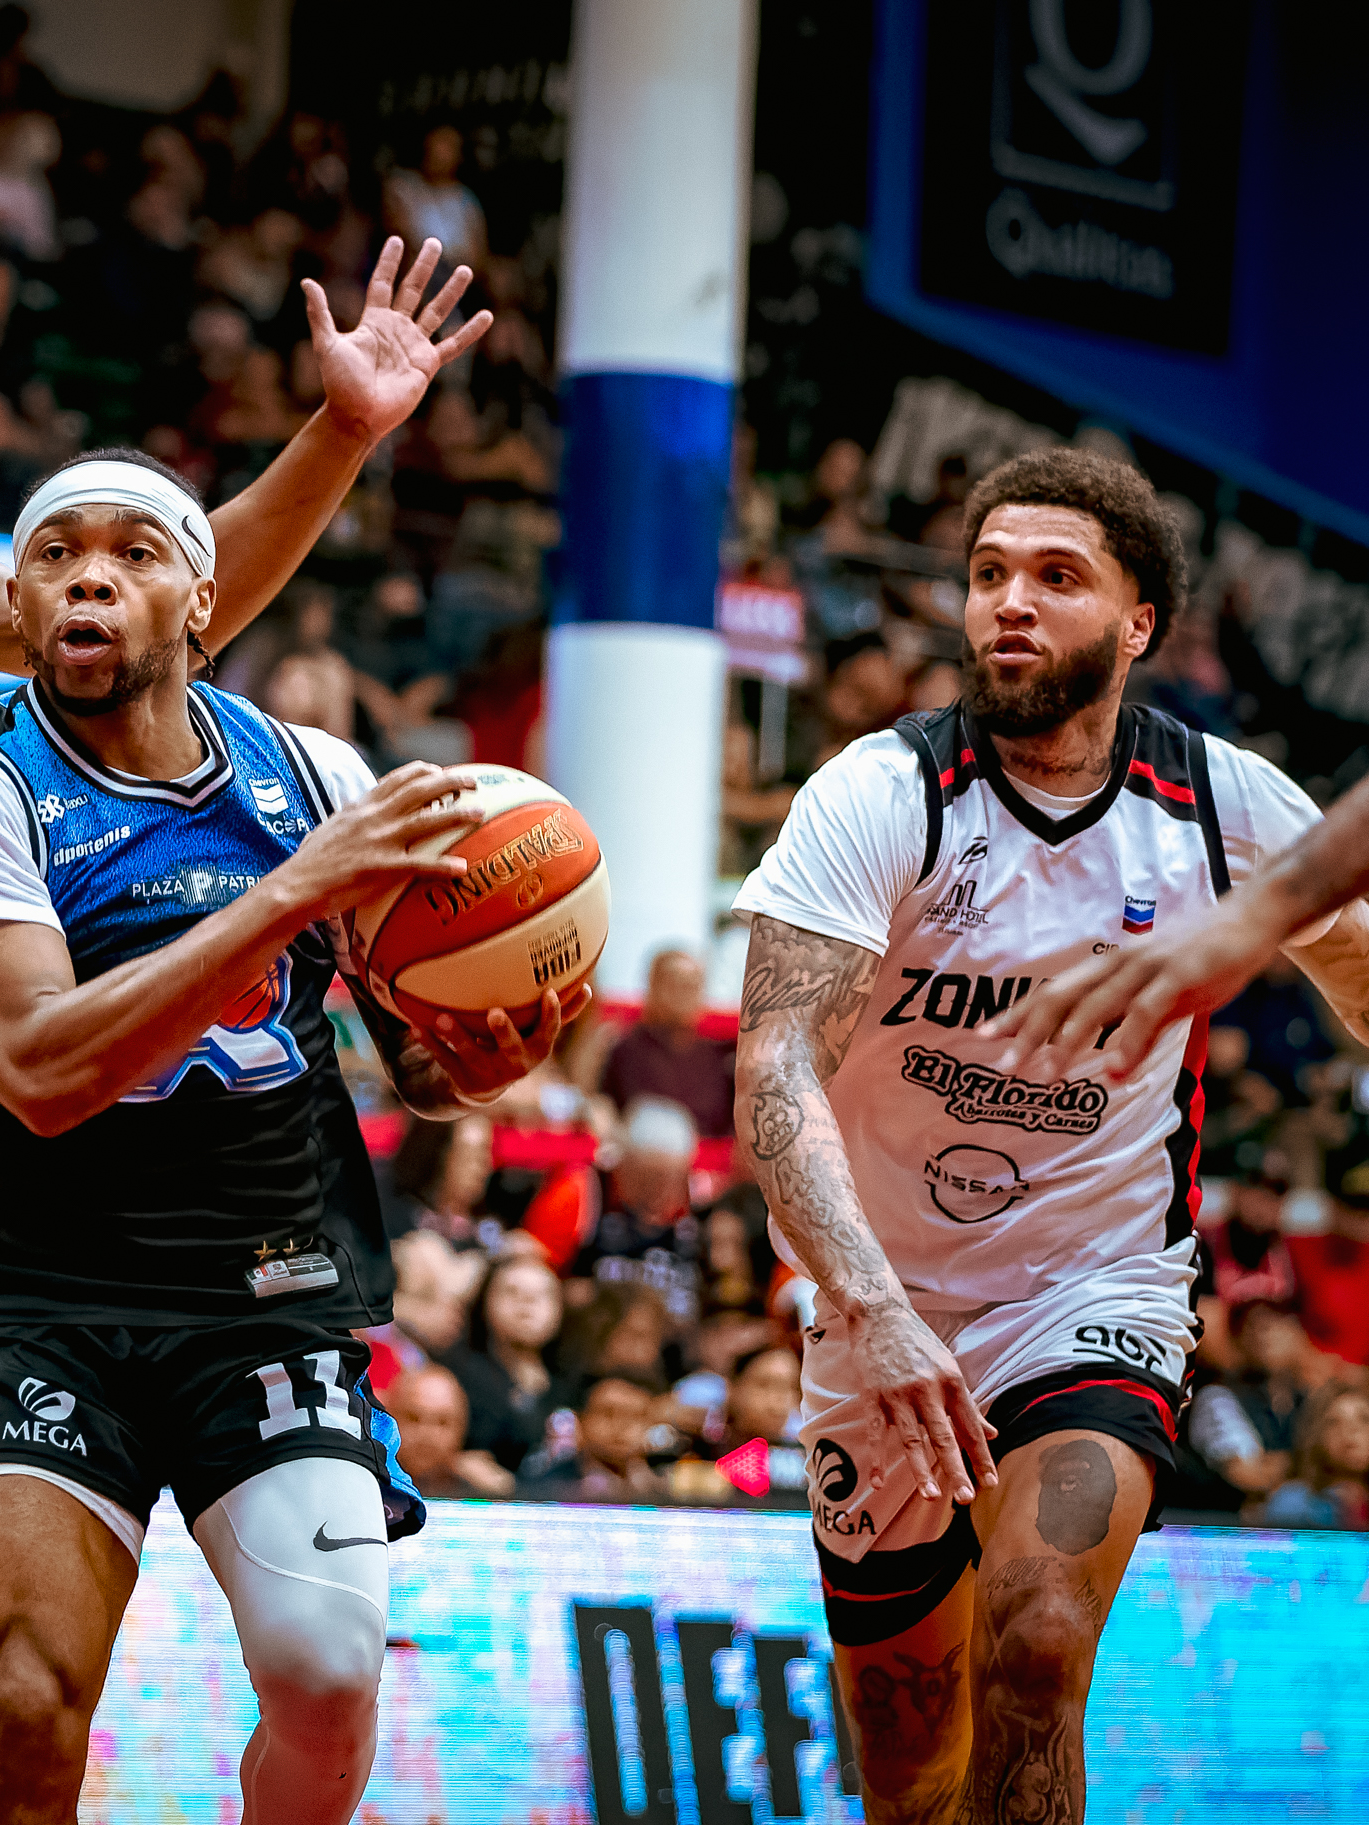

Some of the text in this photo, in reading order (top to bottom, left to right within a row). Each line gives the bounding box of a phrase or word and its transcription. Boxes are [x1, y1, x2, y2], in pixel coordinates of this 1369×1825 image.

[54, 825, 131, 867] dportenis
[132, 879, 185, 898] PLAZA
[907, 1050, 1102, 1113] El Florido
[246, 1349, 362, 1441] 11
[2, 1420, 87, 1457] MEGA
